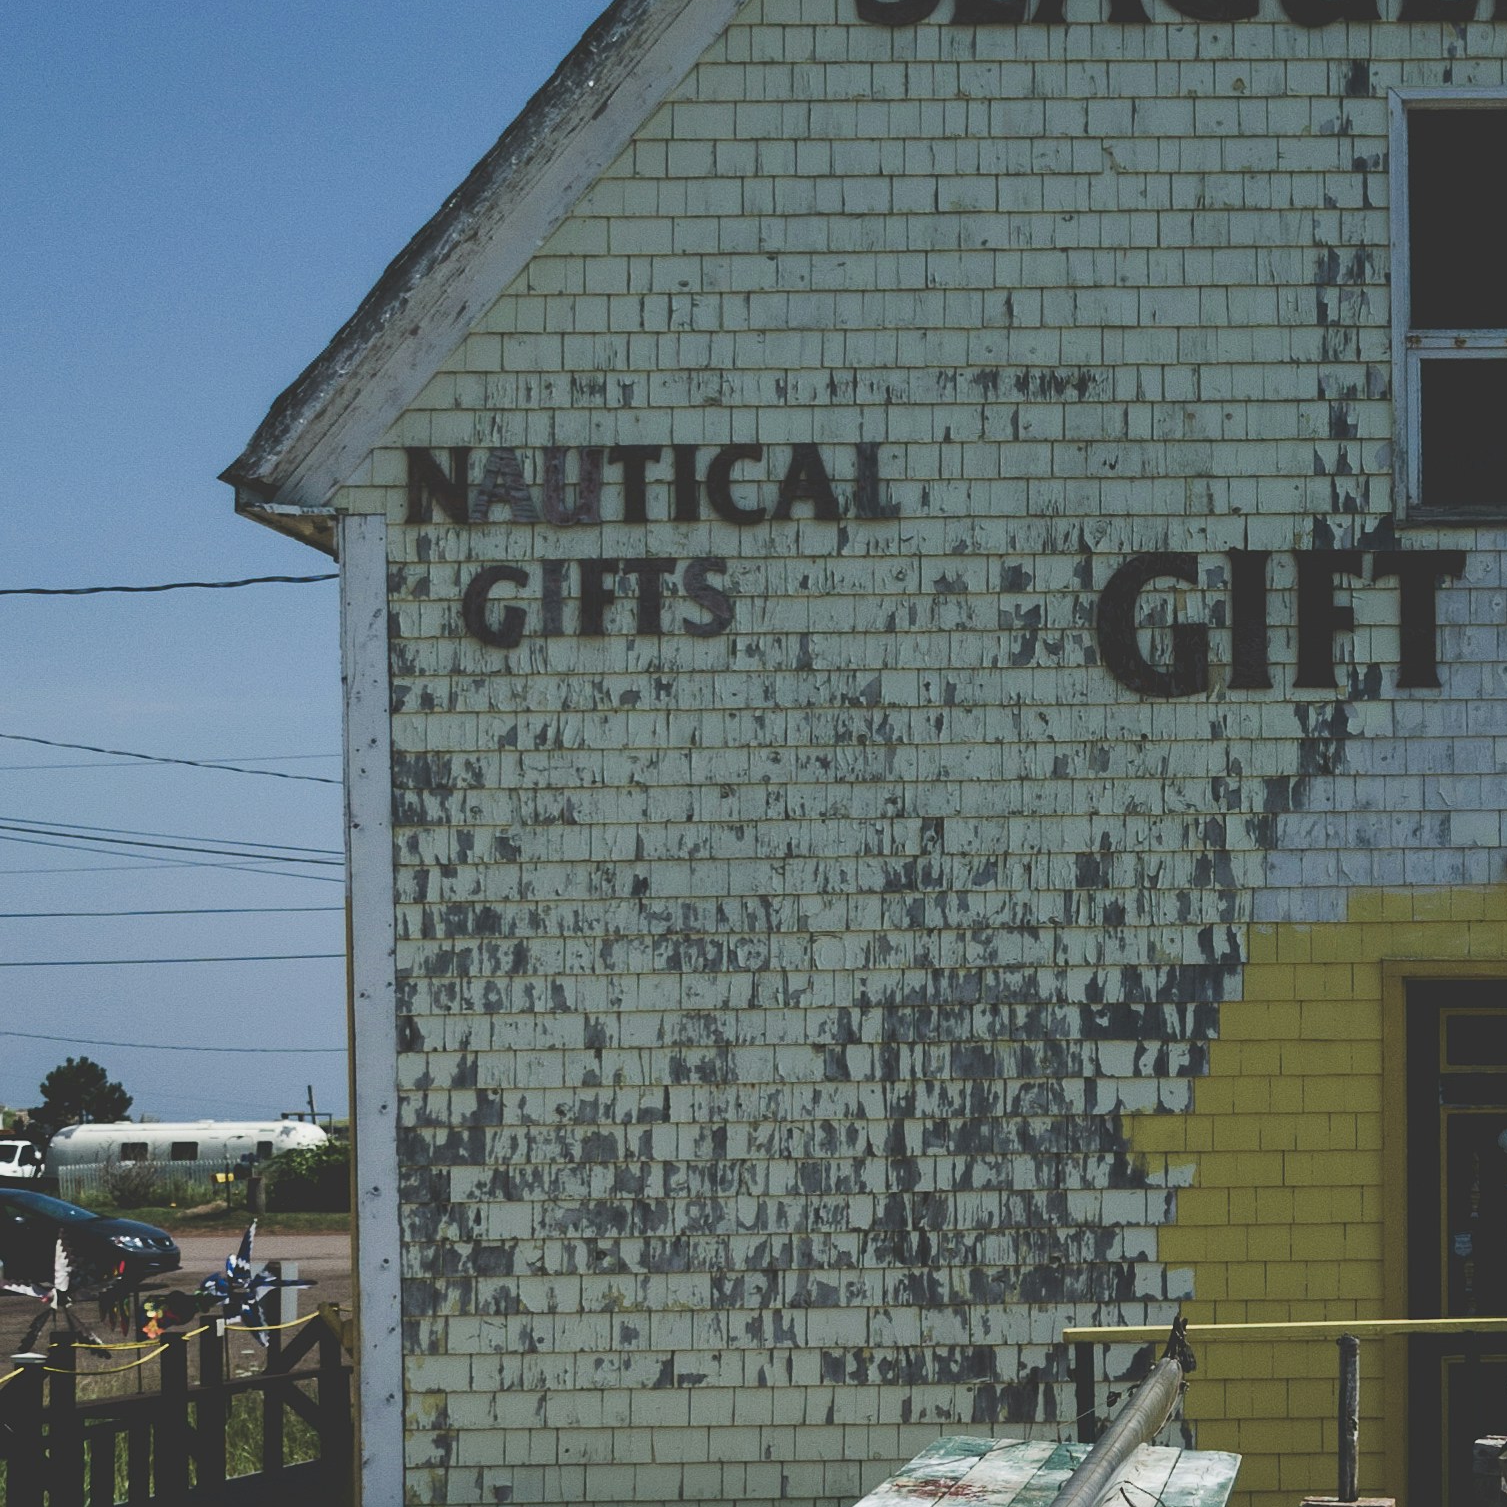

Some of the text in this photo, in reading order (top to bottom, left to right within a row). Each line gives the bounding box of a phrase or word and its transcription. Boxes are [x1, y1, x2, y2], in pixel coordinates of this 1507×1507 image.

[404, 442, 901, 527] NAUTICAL
[462, 557, 734, 649] GIFTS
[1096, 548, 1468, 697] GIFT
